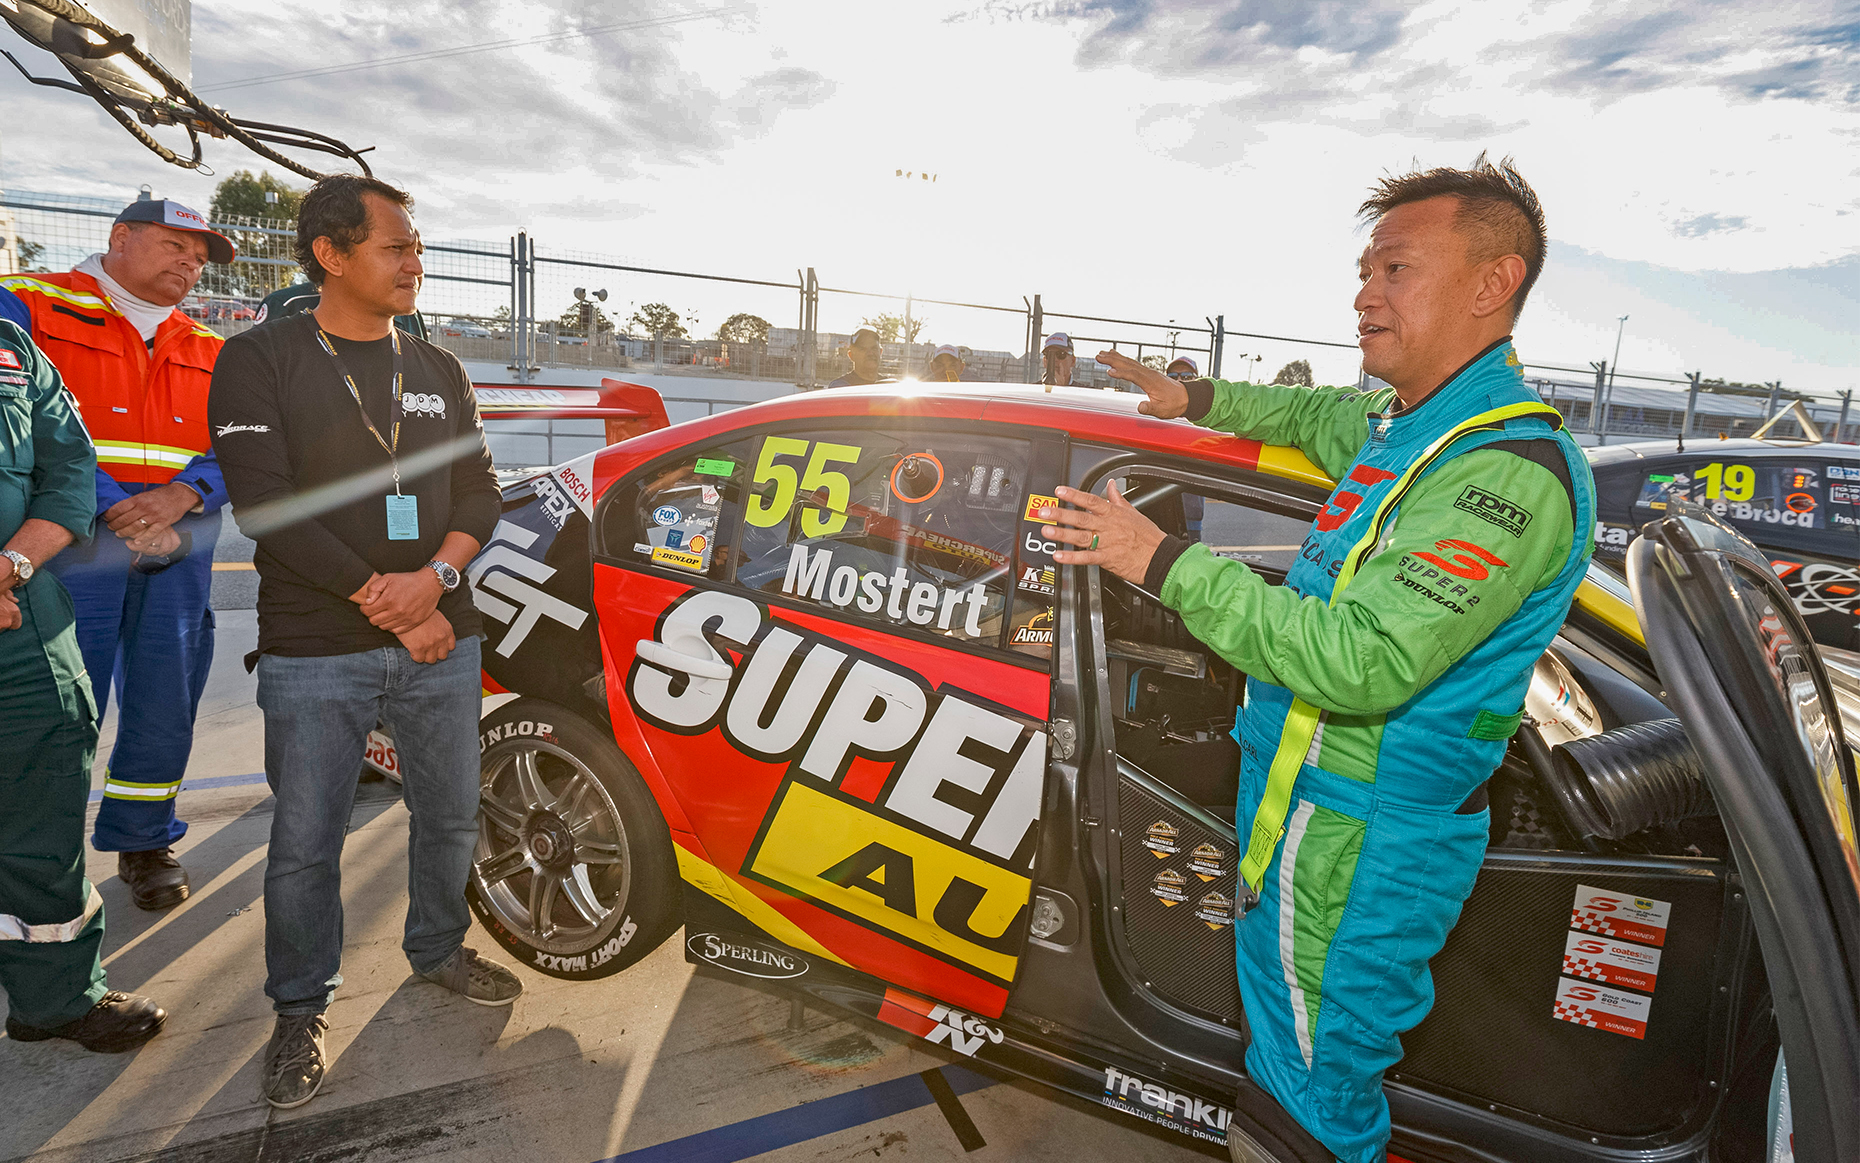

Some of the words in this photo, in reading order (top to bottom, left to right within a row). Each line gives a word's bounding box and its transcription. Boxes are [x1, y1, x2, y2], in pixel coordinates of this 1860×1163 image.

[474, 388, 566, 405] CHEAP
[402, 410, 447, 420] YARD
[560, 467, 591, 503] BOSCH
[745, 436, 861, 539] 55
[1694, 462, 1755, 502] 19
[529, 477, 576, 527] APEX
[540, 505, 563, 531] REPLICAS
[658, 509, 677, 520] FOX
[1457, 502, 1521, 535] RACEWEAR
[1466, 489, 1527, 526] rpm
[662, 552, 699, 565] DUNLOP
[782, 544, 988, 637] Mostert
[1399, 556, 1468, 597] SUPER
[1466, 595, 1480, 607] 2
[1403, 578, 1465, 615] DUNLOP
[591, 915, 638, 971] SPORT
[1623, 929, 1655, 940] WINNER
[534, 950, 588, 972] MAXX
[704, 935, 795, 970] SPERLING
[1614, 975, 1646, 986] WINNER
[1601, 997, 1618, 1005] 600
[1621, 997, 1642, 1005] COAST
[1605, 1022, 1636, 1033] WINNER
[1103, 1096, 1154, 1121] INNOVATIVE
[1156, 1116, 1190, 1135] PEOPLE
